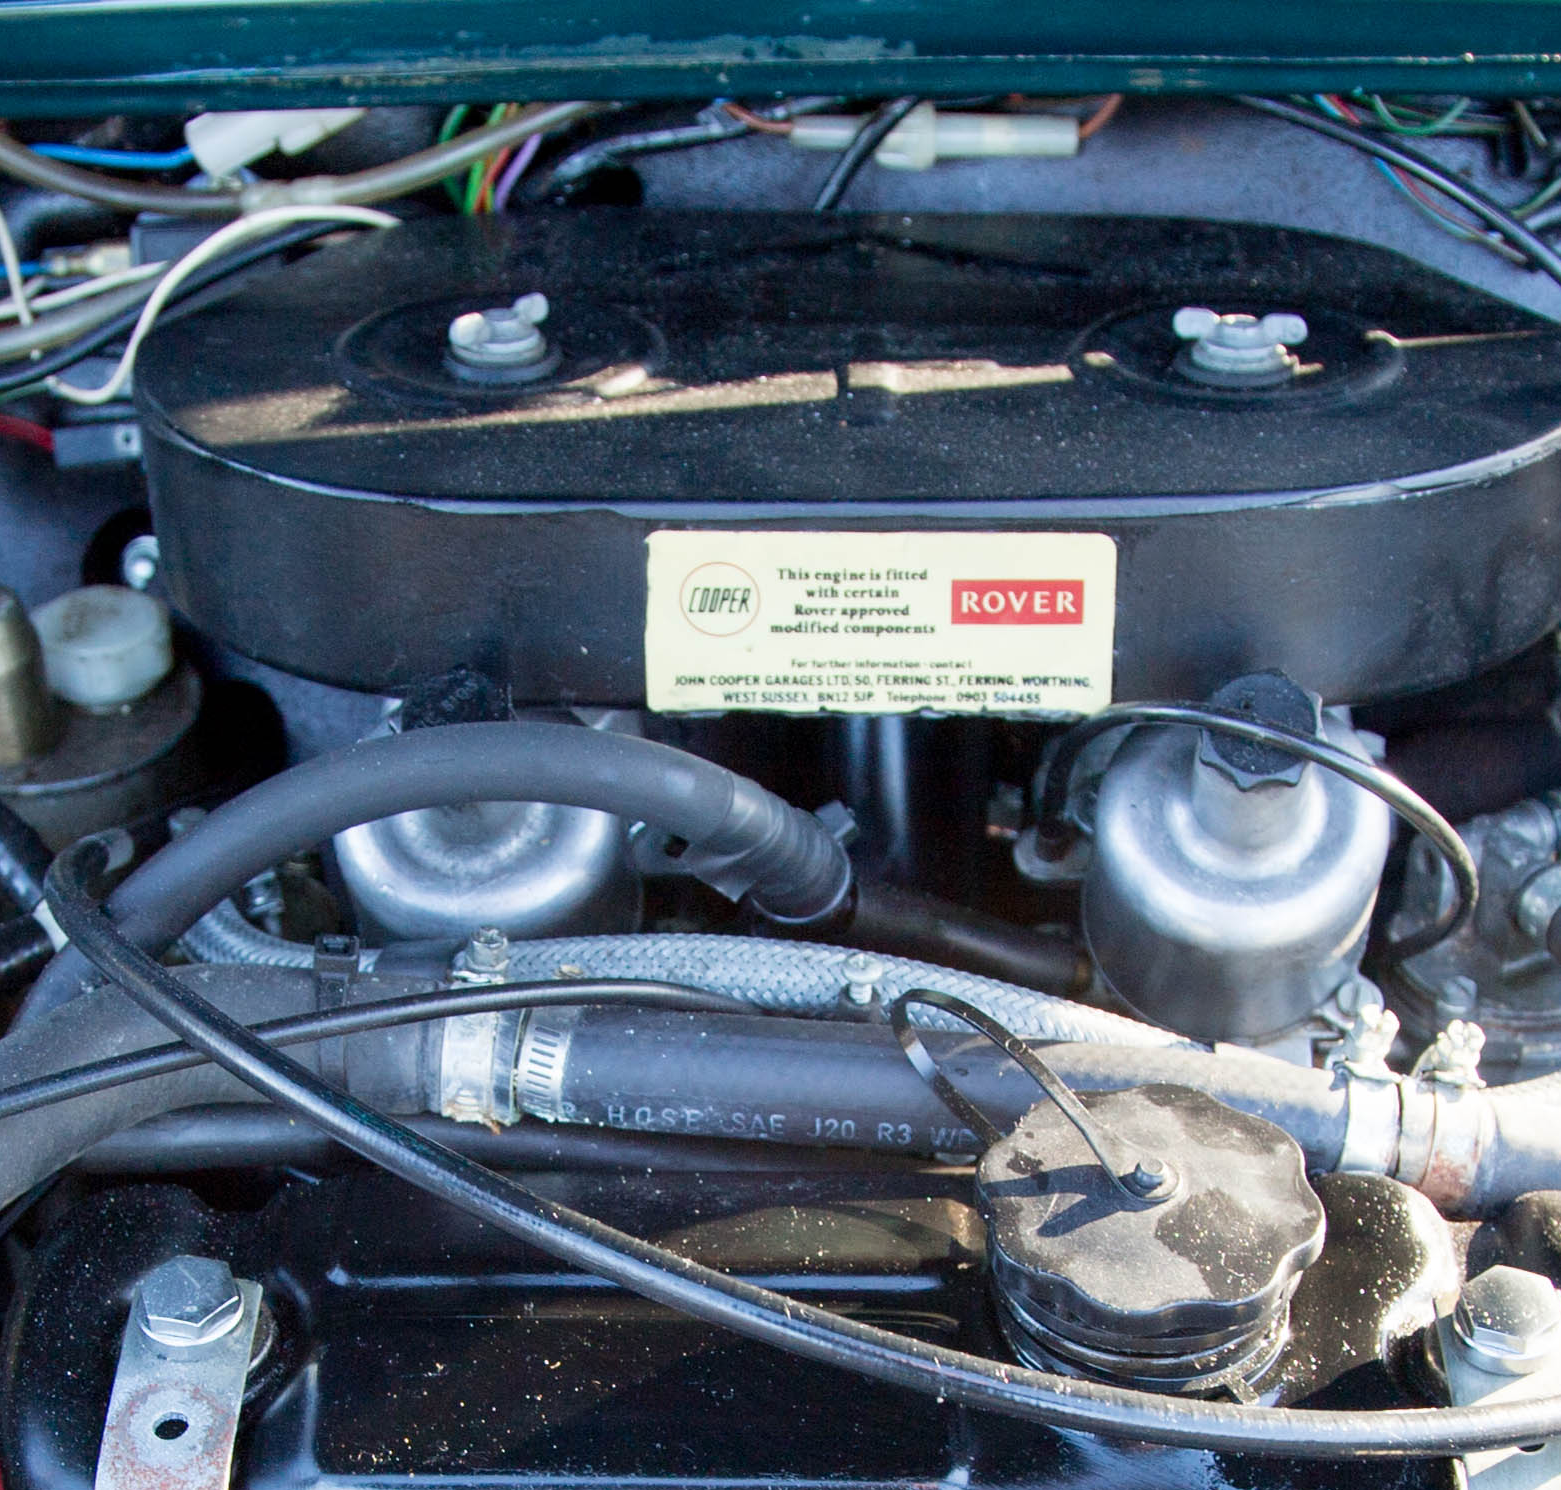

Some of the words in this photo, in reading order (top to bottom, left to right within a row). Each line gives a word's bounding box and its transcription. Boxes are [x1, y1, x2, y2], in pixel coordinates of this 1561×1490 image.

[777, 568, 810, 580] This
[815, 568, 866, 583] engine
[870, 568, 881, 580] is
[886, 568, 928, 580] fitted
[688, 586, 751, 613] COOPER
[806, 587, 839, 598] with
[843, 586, 900, 598] certain
[960, 590, 1077, 614] ROVER
[794, 604, 837, 616] Rover
[841, 604, 910, 619] approved
[770, 621, 839, 633] modified
[844, 622, 935, 637] components
[791, 659, 808, 668] For
[812, 659, 852, 668] further
[855, 658, 920, 668] information
[675, 675, 705, 686] JOHN
[709, 675, 760, 686] COOPER
[765, 675, 823, 686] GARAGES
[876, 675, 931, 686] FERRING
[723, 691, 757, 703] WEST
[956, 690, 987, 702] 0903
[607, 1104, 704, 1128] HOSE
[731, 1112, 786, 1135] SAE
[806, 1116, 856, 1139] J20
[877, 1122, 913, 1145] R3
